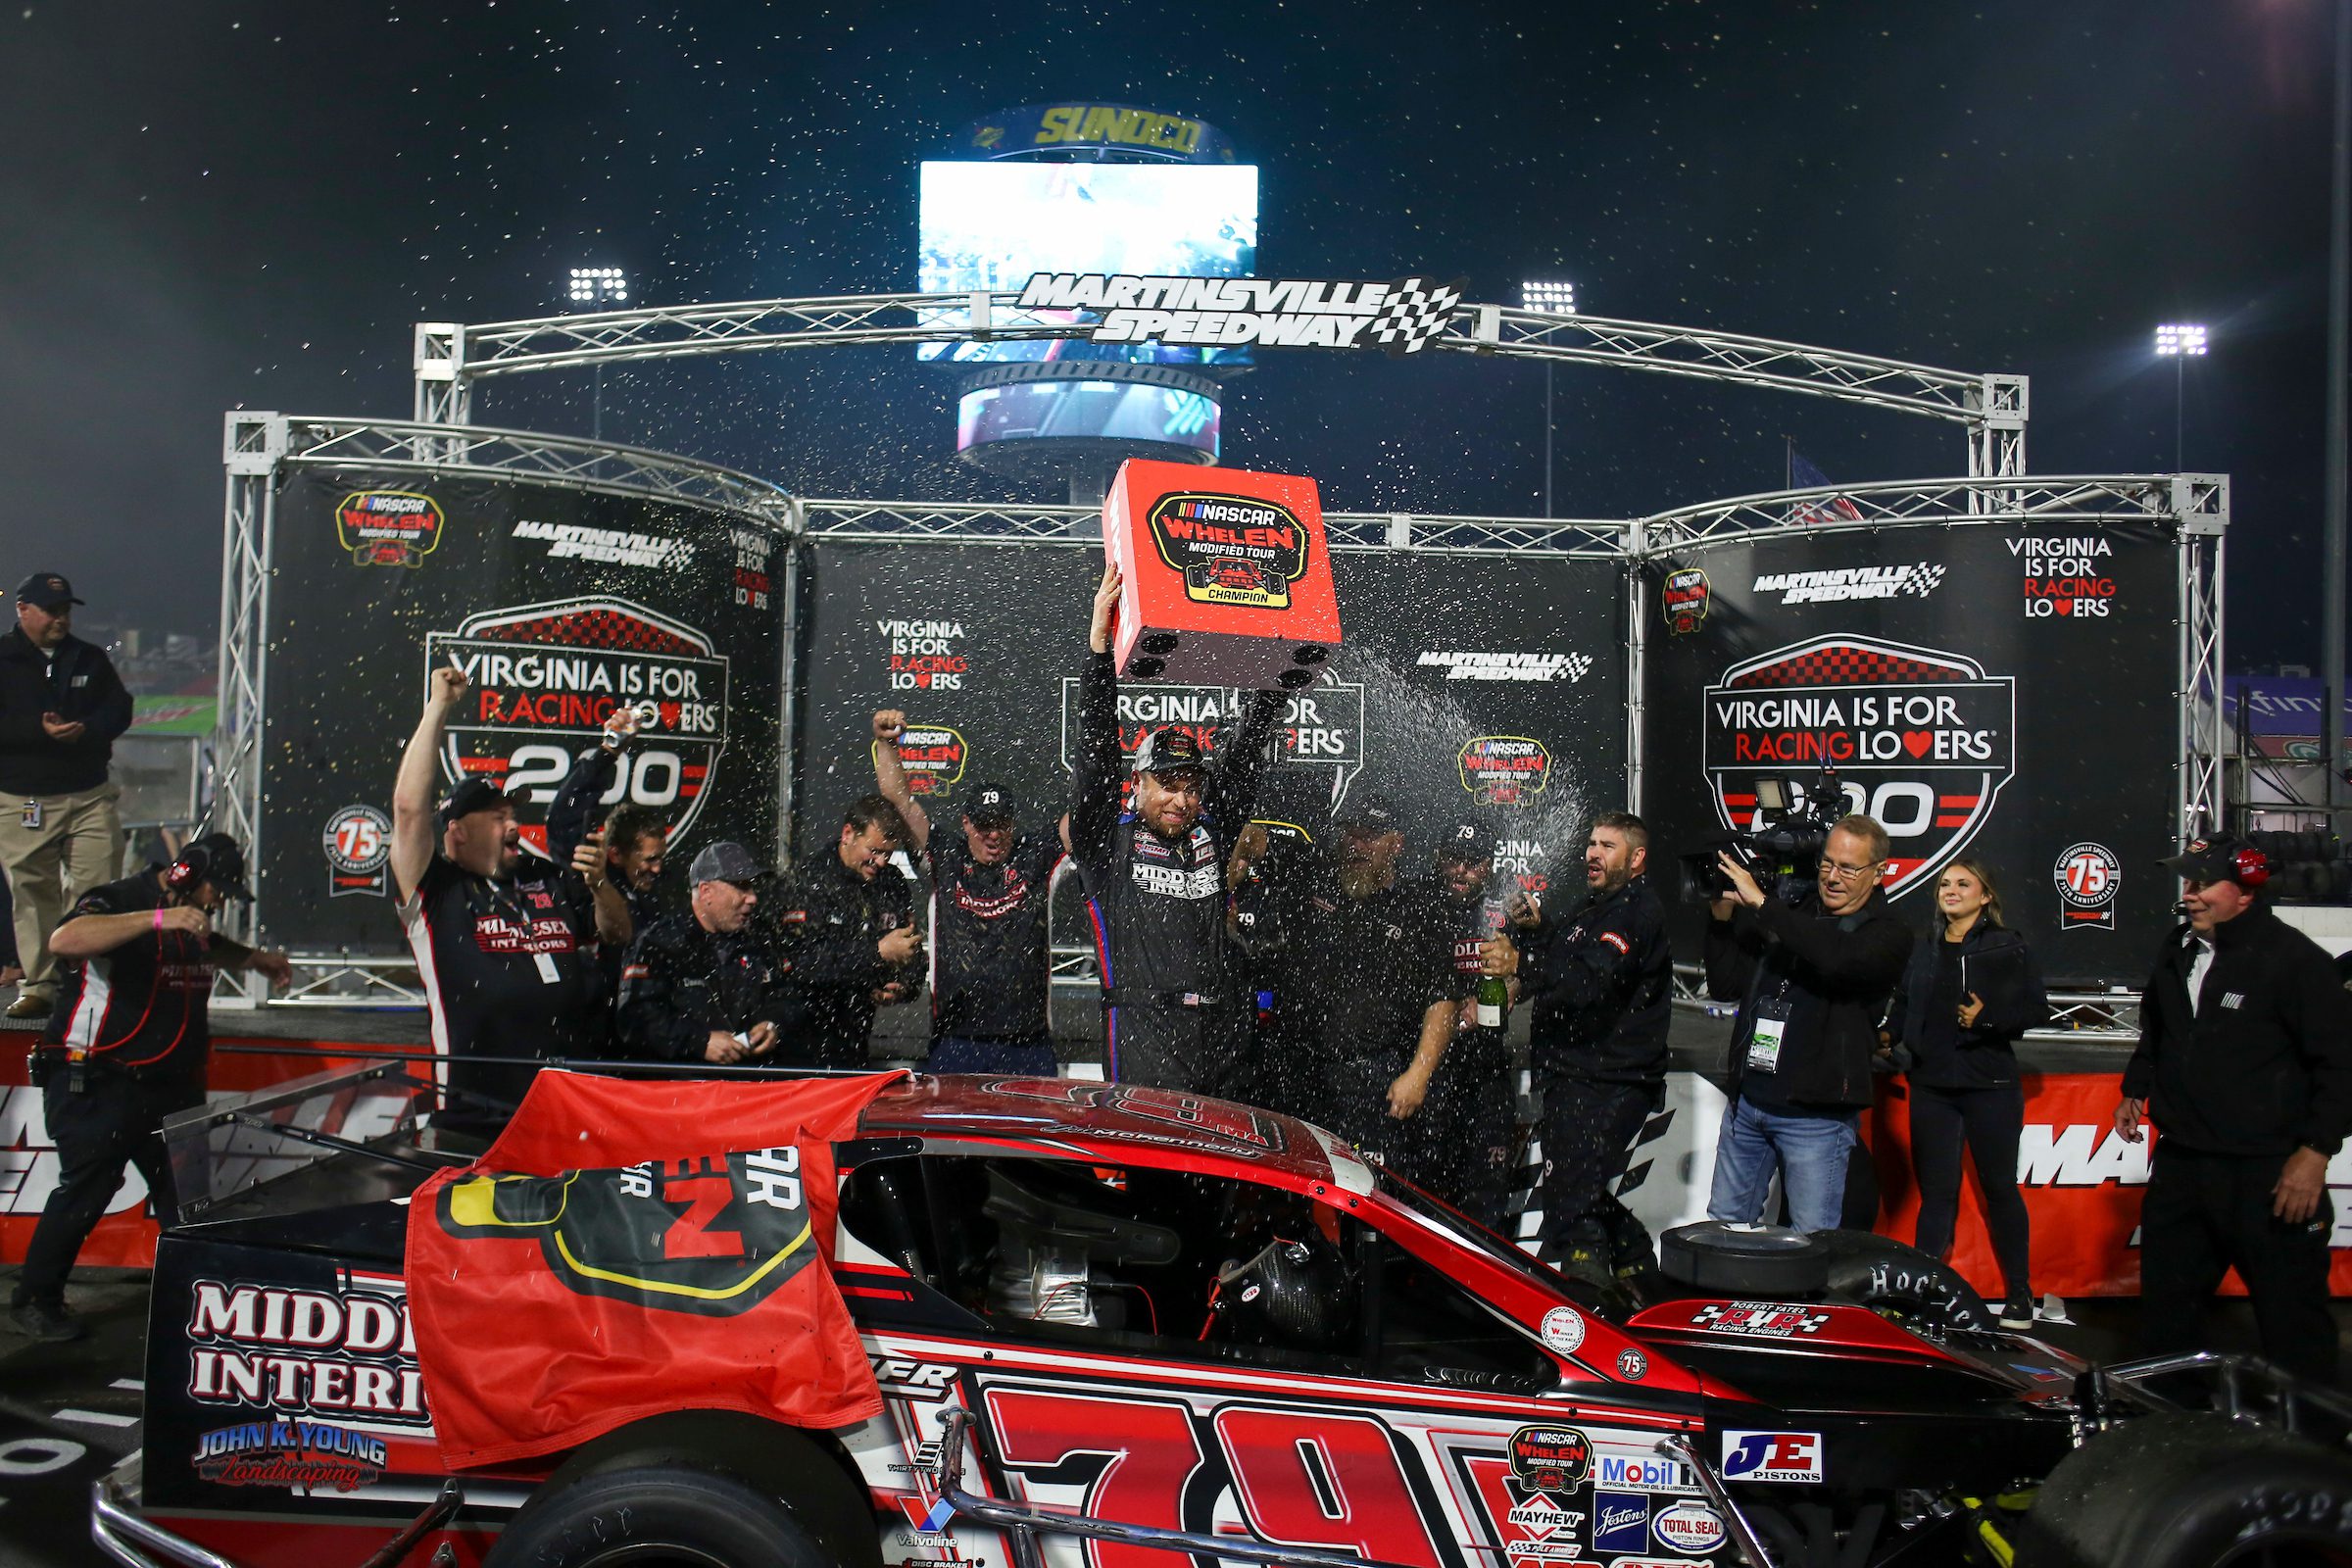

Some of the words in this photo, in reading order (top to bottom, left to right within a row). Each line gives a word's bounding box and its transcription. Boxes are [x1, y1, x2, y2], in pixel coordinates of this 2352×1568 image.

[1035, 107, 1201, 154] SUNOCO
[1018, 273, 1391, 316] MARTINSVILLE
[1092, 311, 1374, 349] SPEEDWAY
[371, 496, 426, 513] NASCAR
[1200, 502, 1277, 526] NASCAR
[343, 509, 435, 531] WHELEN
[512, 520, 672, 554] MARTINSVILLE
[1160, 514, 1296, 551] WHELEN
[729, 529, 771, 558] VIRGINIA
[1189, 542, 1244, 559] MODIFIED
[1244, 545, 1276, 561] TOUR
[2005, 538, 2113, 557] VIRGINIA
[547, 541, 666, 568] SPEEDWAY
[746, 554, 766, 573] FOR
[2025, 558, 2043, 576] IS
[2046, 558, 2096, 577] FOR
[1676, 572, 1701, 588] NASCAR
[1753, 564, 1912, 593] MARTINSVILLE
[2025, 578, 2117, 597] RACING
[1206, 588, 1269, 606] CHAMPION
[1665, 582, 1708, 604] WHELEN
[1782, 581, 1904, 605] SPEEDWAY
[877, 620, 965, 640] VIRGINIA
[892, 639, 909, 656] IS
[910, 639, 952, 656] FOR
[891, 656, 968, 674] RACING
[1417, 651, 1565, 669] MARTINSVILLE
[448, 653, 613, 694] VIRGINIA
[618, 663, 644, 695] IS
[649, 665, 702, 700] FOR
[1446, 666, 1560, 682] SPEEDWAY
[479, 689, 615, 726] RACING
[1116, 695, 1221, 723] RGINIA
[1715, 699, 1846, 730] VIRGINIA
[1853, 697, 1880, 726] IS
[1886, 695, 1965, 726] FOR
[903, 731, 952, 745] NASCAR
[1735, 731, 1854, 761] RACING
[899, 745, 960, 761] HELEN
[1489, 742, 1535, 756] NASCAR
[927, 761, 947, 770] TOUR
[1464, 753, 1544, 771] WHELEN
[1512, 770, 1531, 780] TOUR
[982, 791, 1000, 805] 79
[339, 820, 378, 858] 75
[1457, 825, 1475, 840] 79
[1493, 839, 1544, 857] GINIA
[2059, 845, 2092, 868] MARTINSVILLE
[2091, 846, 2117, 869] SPEEDWAY
[2068, 858, 2106, 893] 75
[527, 892, 555, 909] 79
[2059, 881, 2074, 899] 75TH
[2073, 882, 2116, 905] ANNIVERSARY
[1238, 912, 1255, 927] 79
[1731, 1301, 1775, 1312] ROBERT
[1774, 1304, 1807, 1314] YATES
[190, 1282, 416, 1353] MIDD
[1715, 1308, 1808, 1331] RYR
[1709, 1324, 1747, 1333] RACING
[1747, 1326, 1791, 1337] ENGINES
[1624, 1355, 1642, 1373] 75
[191, 1348, 431, 1417] INTERI
[193, 1423, 266, 1461] JOHN
[270, 1422, 297, 1446] K.
[297, 1423, 386, 1467] YOUNG
[1537, 1432, 1578, 1446] NASCAR
[1516, 1442, 1586, 1460] WHELEN
[1724, 1434, 1815, 1477] JE
[888, 1464, 918, 1473] THIRTY
[1527, 1457, 1556, 1467] MODIFIED
[1556, 1458, 1573, 1468] TOUR
[1602, 1457, 1673, 1485] Mobil
[217, 1456, 362, 1491] Landscaping
[983, 1387, 1447, 1568] 79
[1753, 1471, 1821, 1481] PISTONS
[1510, 1510, 1578, 1525] MAYHEW
[1594, 1505, 1647, 1537] Jostens
[1663, 1519, 1692, 1534] TOTAL
[1695, 1521, 1720, 1536] SEAL
[897, 1534, 958, 1547] Valvoline
[1531, 1544, 1549, 1553] POLE
